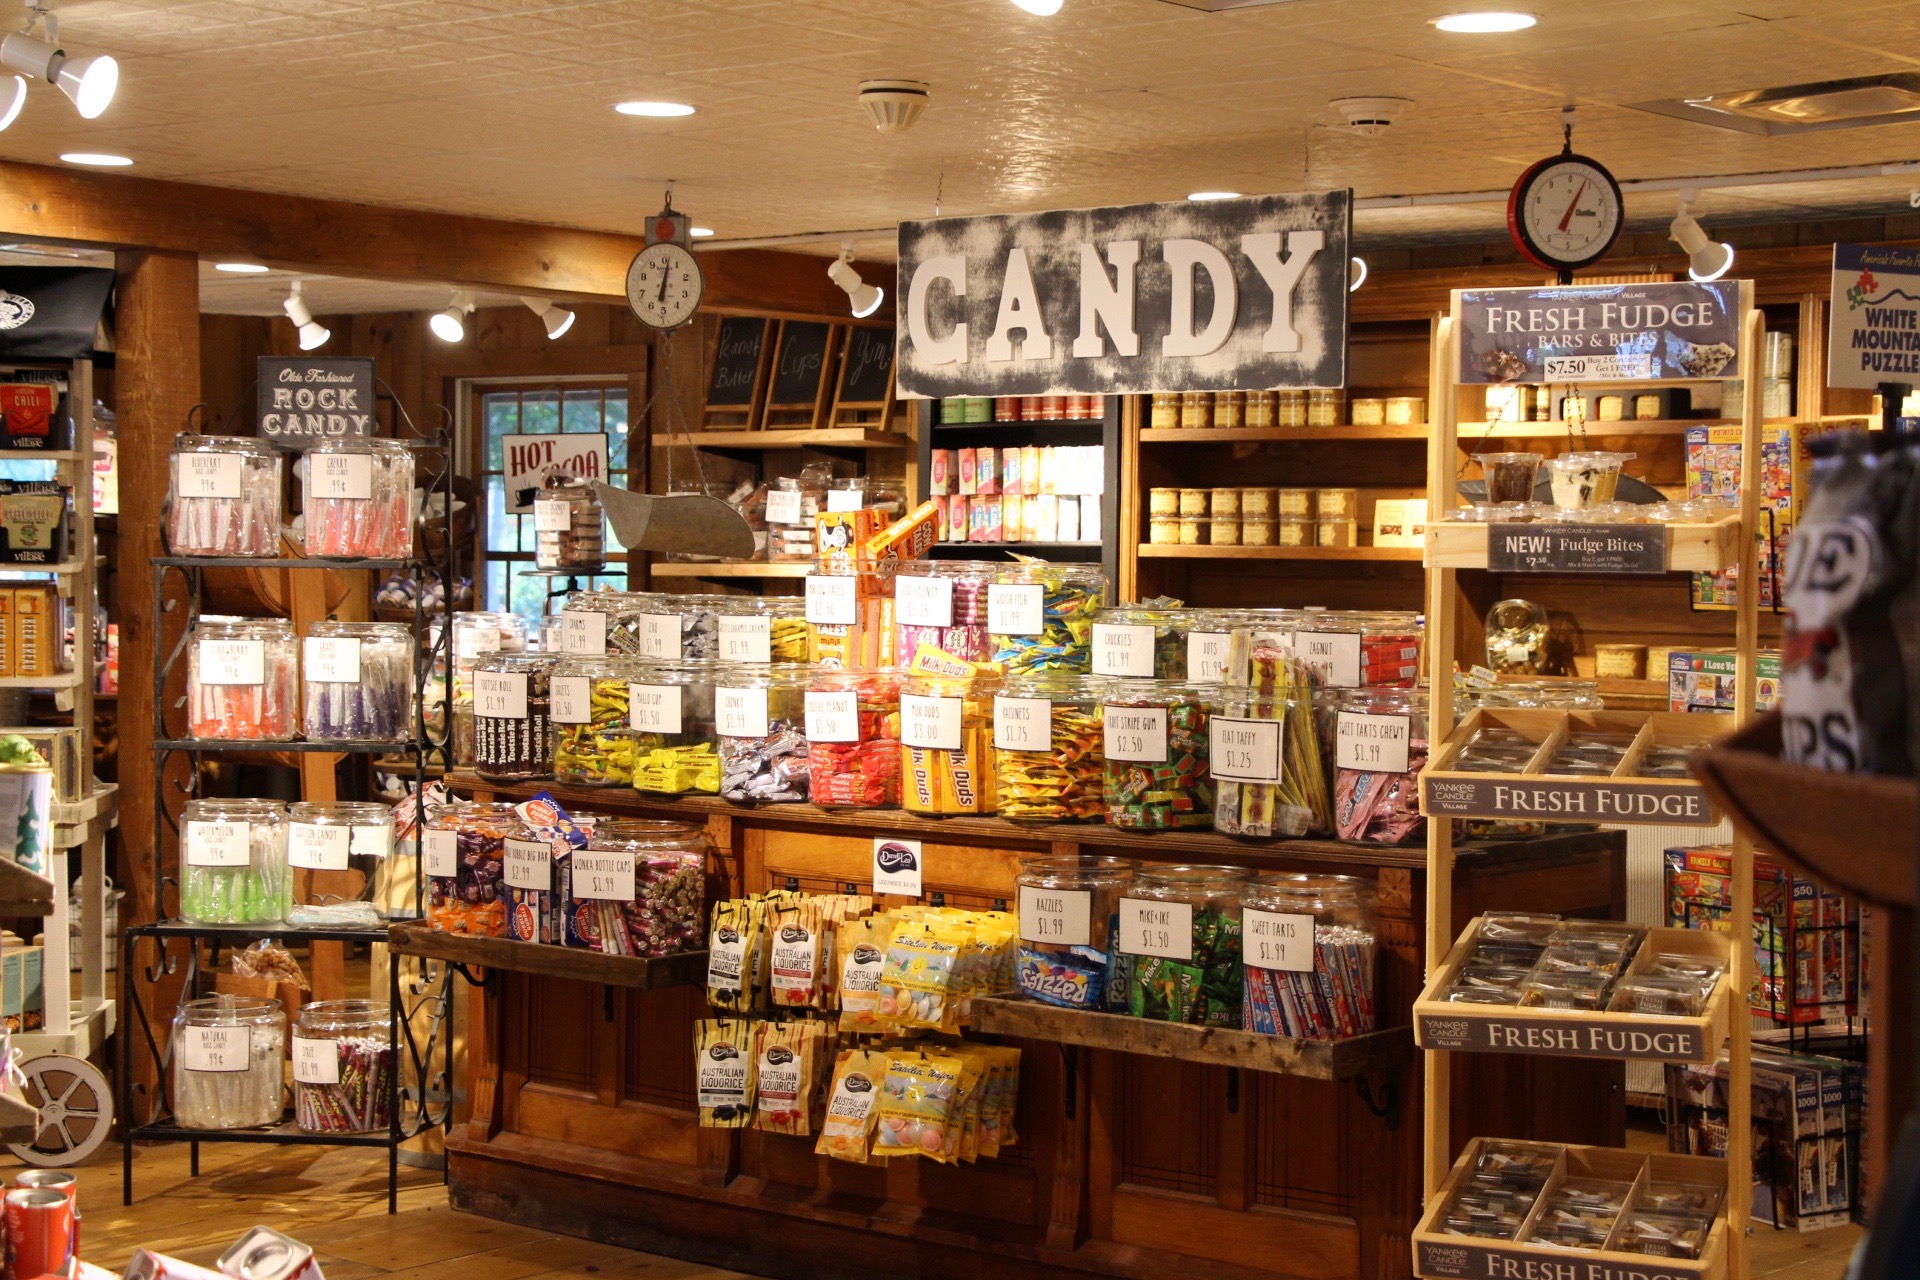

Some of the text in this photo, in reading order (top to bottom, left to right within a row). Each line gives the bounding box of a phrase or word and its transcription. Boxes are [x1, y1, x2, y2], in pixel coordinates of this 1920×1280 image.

[907, 230, 1326, 365] CANDY
[1485, 302, 1713, 333] FRESH FUDGE
[1865, 308, 1917, 329] WHITE
[719, 326, 760, 358] Peanut
[1538, 331, 1658, 349] BARS & BITES
[781, 336, 820, 379] Cups
[1862, 352, 1920, 373] PUZZLE
[1547, 359, 1586, 375] $7.50
[279, 367, 355, 384] Olde Fashioned
[716, 366, 755, 388] Butter
[14, 395, 40, 407] CHILI
[273, 387, 358, 411] ROCK
[262, 413, 369, 436] CANDY
[191, 457, 221, 469] BLUEBERRY
[327, 457, 347, 469] CHERRY
[510, 440, 556, 477] HOT
[18, 482, 60, 494] village
[1506, 536, 1644, 555] NEW! Fudge Bites
[14, 551, 45, 562] village
[1525, 556, 1546, 567] $7.50
[570, 635, 585, 649] $1.99
[1105, 633, 1132, 647] CHUCKLES
[1203, 642, 1217, 655] DOTS
[1309, 641, 1333, 656] ZAGNUT
[919, 655, 968, 677] Milk Duds
[1107, 652, 1129, 668] $1.99
[1709, 661, 1724, 670] Love
[1726, 661, 1735, 671] Ve
[1201, 661, 1222, 677] $1.99
[480, 678, 512, 692] TOOTSIE ROLL
[486, 696, 505, 710] $1.99
[637, 692, 650, 705] MALLO
[640, 711, 660, 725] $1.50
[912, 705, 940, 719] MILK DUDS
[1002, 706, 1030, 720] RAISINETS
[726, 714, 745, 729] $1.99
[1107, 715, 1157, 731] FRUIT STRIPE GUM
[914, 723, 937, 739] $3.00
[1005, 726, 1028, 742] $1.75
[1222, 730, 1234, 744] FLAT
[1237, 731, 1256, 746] TAFFY
[1338, 721, 1404, 740] SWEET TARTS CHEWY
[507, 731, 515, 762] Tootsie
[534, 714, 542, 764] Tootsie Roll
[1117, 736, 1142, 753] $2.50
[1226, 750, 1251, 769] $1.25
[1355, 744, 1380, 762] $1.99
[913, 769, 931, 806] Duds
[954, 769, 974, 807] Duds
[1493, 785, 1700, 817] FRESH FUDGE
[198, 826, 234, 837] WATERMELON
[296, 826, 337, 841] COTTON CANDY
[527, 850, 549, 863] BIG BAR
[574, 858, 632, 873] WONKA BOTTLE CAPS
[512, 866, 530, 881] $2.99
[593, 877, 614, 892] $1.99
[1794, 886, 1812, 897] 550
[1036, 897, 1063, 913] RAZZLES
[1139, 909, 1170, 926] MIKE IKE
[1038, 917, 1063, 936] $1.99
[1251, 919, 1295, 938] SWEET TARTS
[1142, 929, 1169, 948] $1.50
[713, 949, 740, 962] AUSTRALIAN
[775, 948, 811, 960] AUSTRALIAN
[1260, 942, 1285, 961] $1.99
[711, 960, 739, 973] LIQUORICE
[774, 958, 811, 970] LIQUORICE
[1020, 966, 1088, 1003] Razzles
[201, 1031, 227, 1043] NATURAL
[1487, 1023, 1692, 1054] FRESH FUDGE
[205, 1053, 223, 1066] .99¢
[301, 1063, 318, 1076] $1.99
[702, 1068, 744, 1078] AUSTRALIAN
[760, 1070, 797, 1081] AUSTRALIAN
[701, 1077, 743, 1089] LIQUORICE
[760, 1080, 796, 1092] LIQUORICE
[833, 1095, 869, 1109] AUSTRALIAN
[1798, 1096, 1816, 1108] 1000
[1823, 1092, 1842, 1103] 1000
[829, 1104, 866, 1119] LIQUORICE
[1486, 1253, 1576, 1280] FRESH
